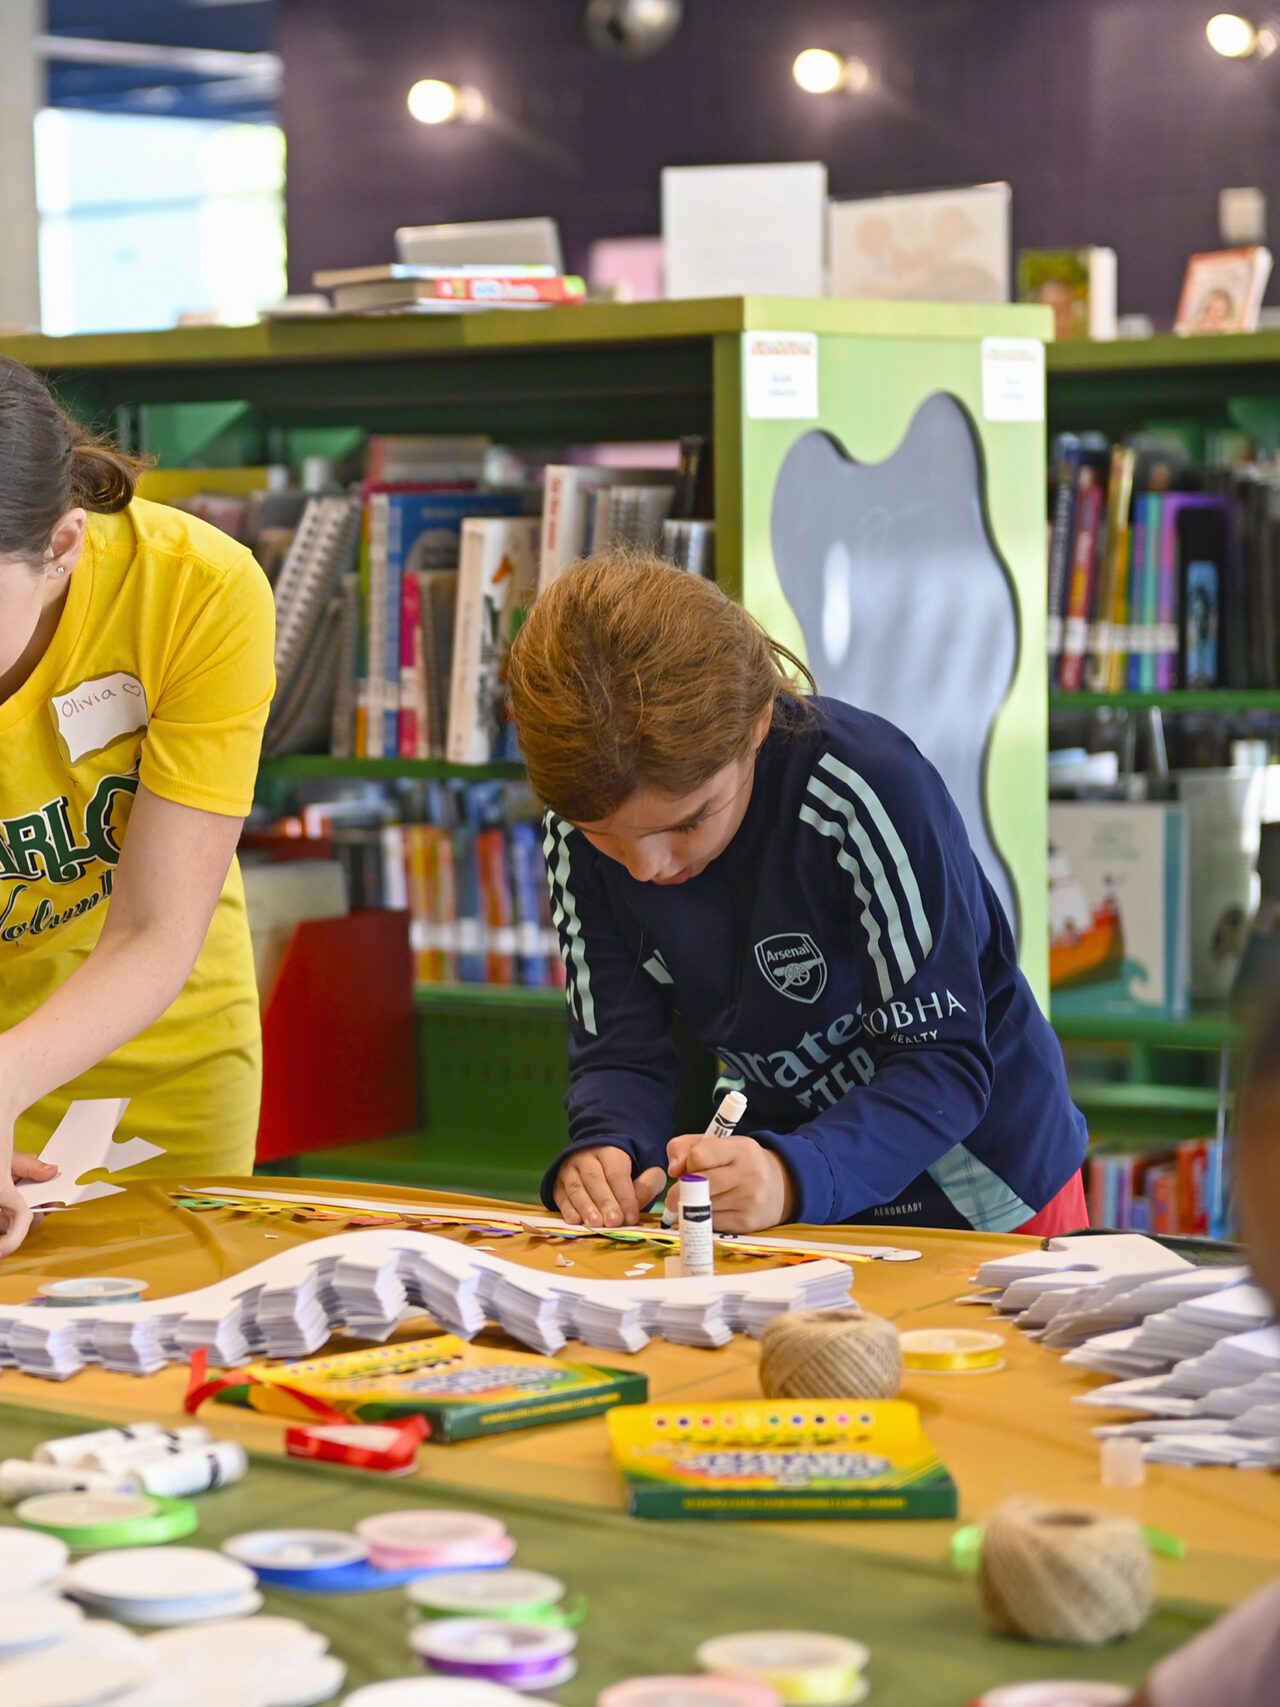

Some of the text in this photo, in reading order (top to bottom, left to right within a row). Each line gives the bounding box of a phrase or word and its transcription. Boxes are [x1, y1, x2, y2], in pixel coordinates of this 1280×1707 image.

[61, 689, 117, 718] Olivia
[766, 943, 810, 963] Arsenal
[890, 1029, 938, 1044] REALTY
[874, 1201, 923, 1217] AEROREADY
